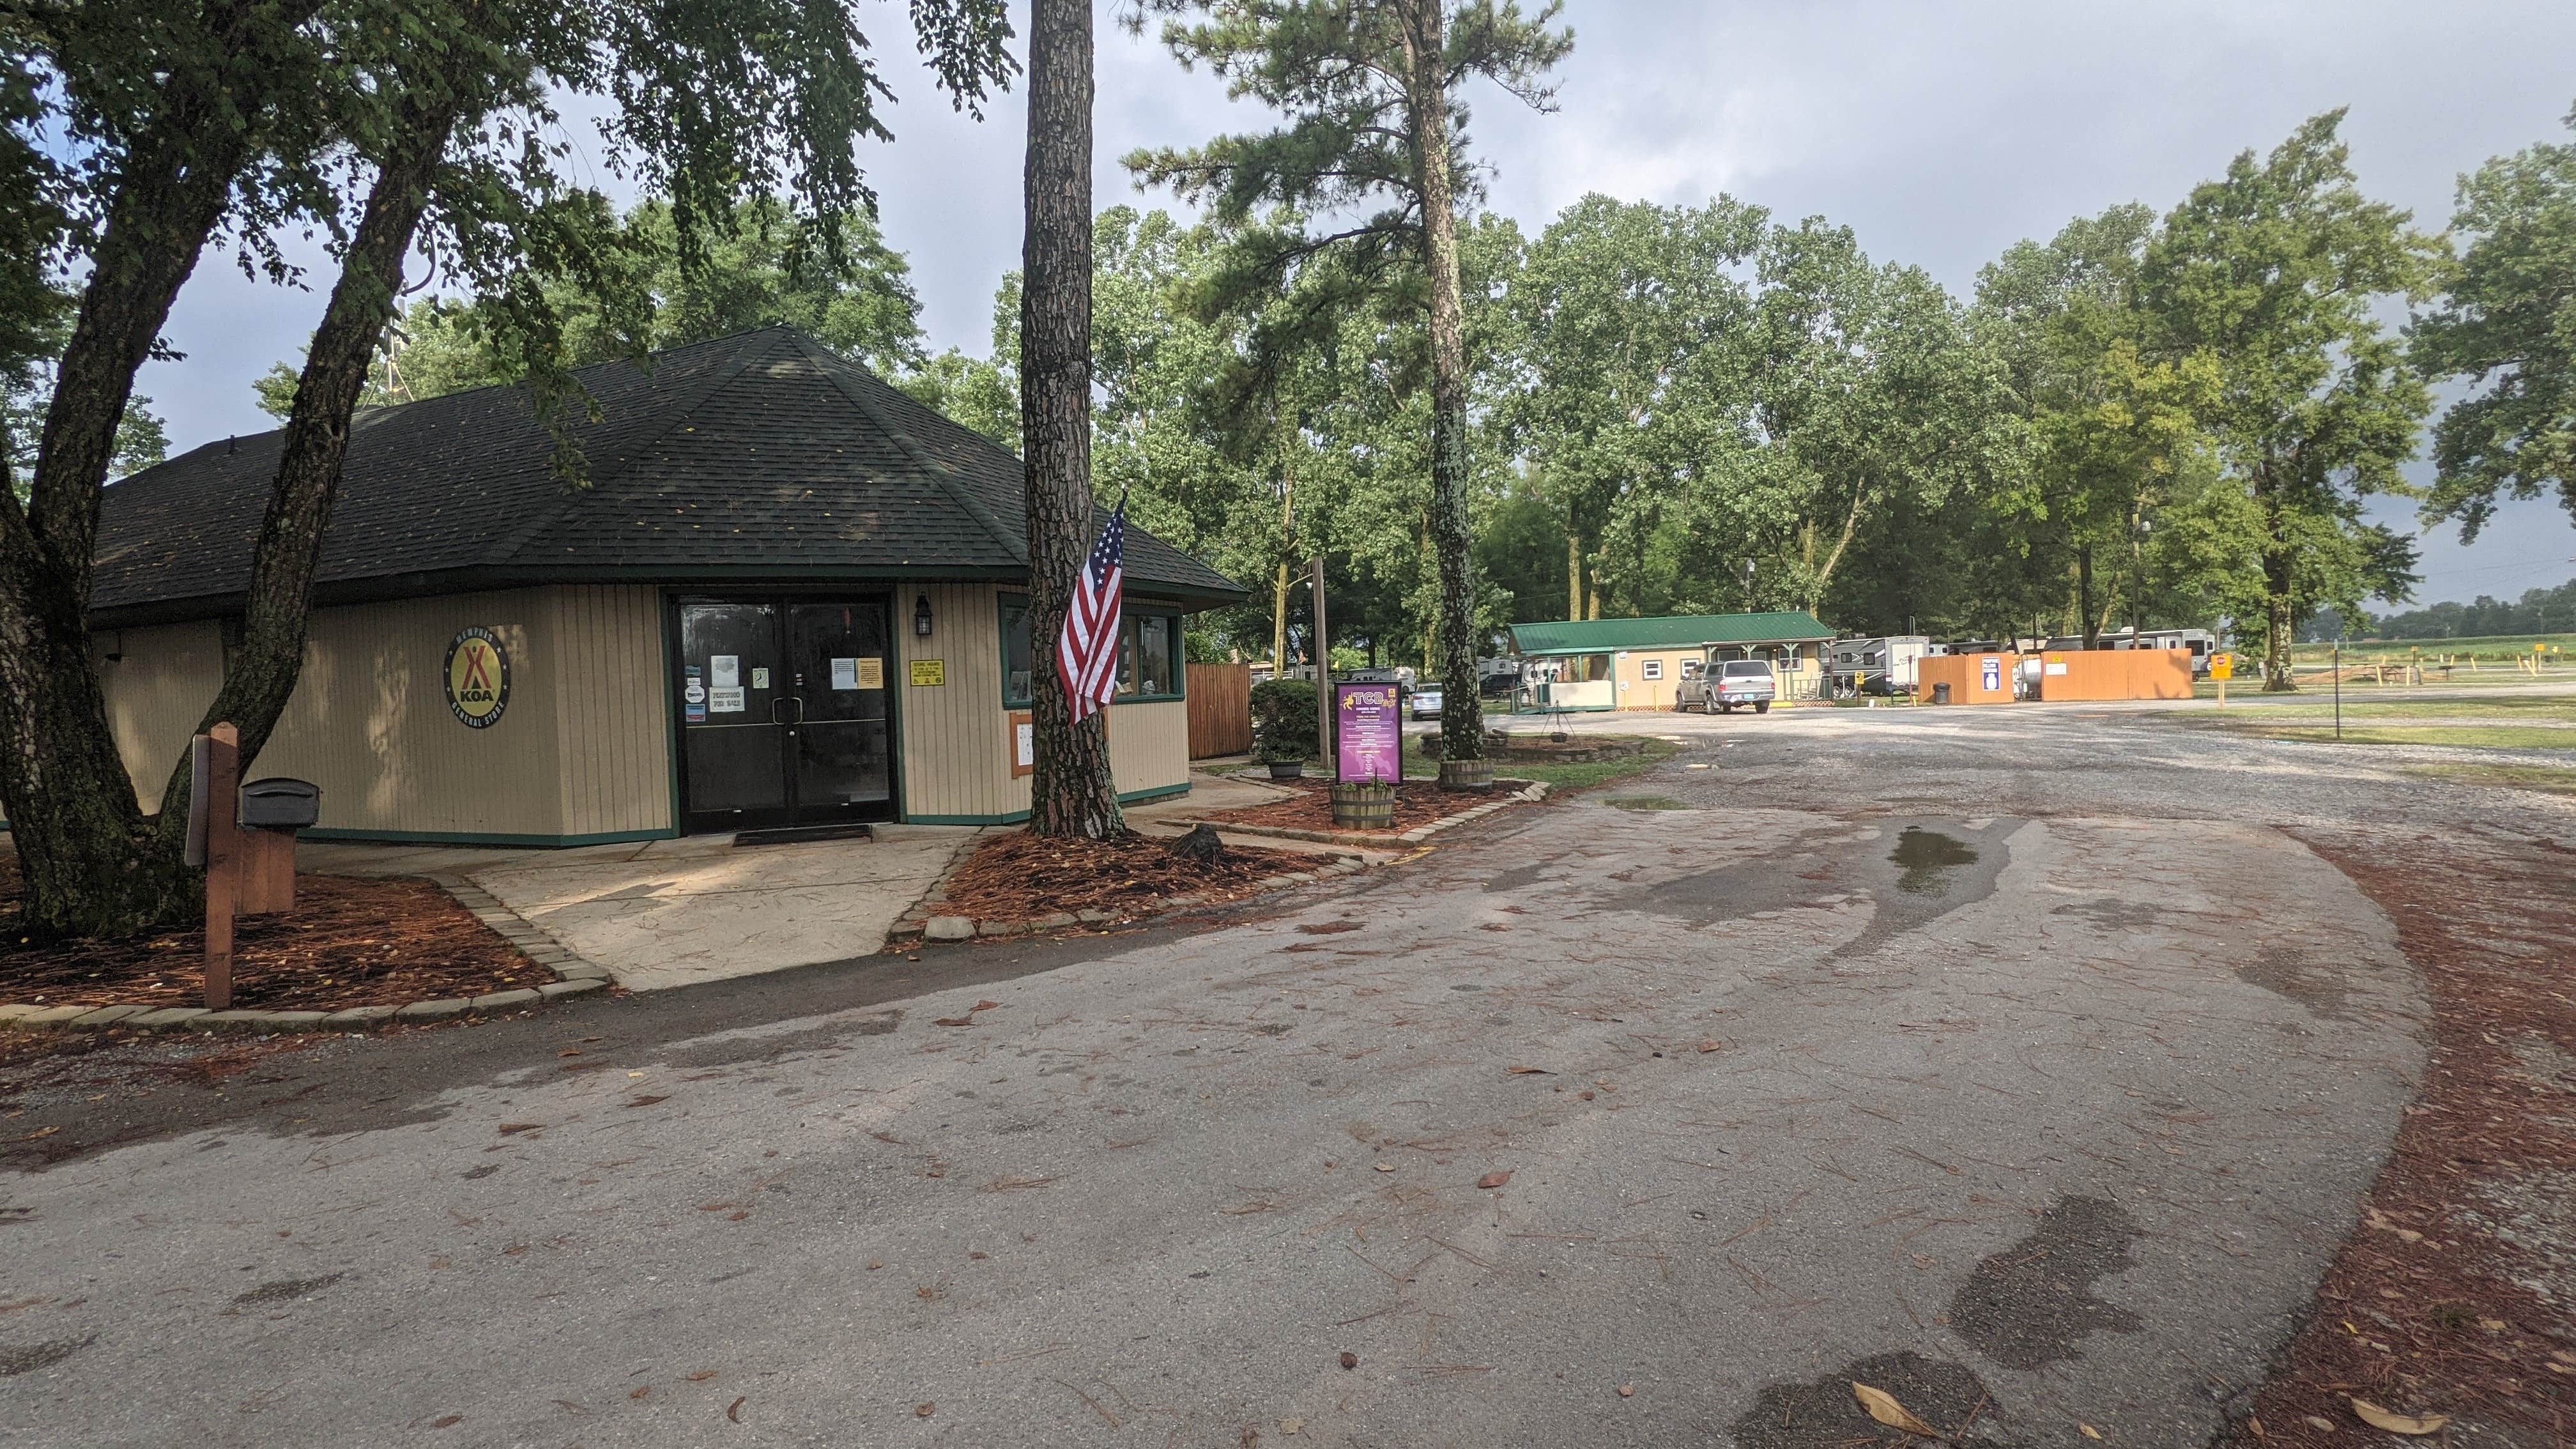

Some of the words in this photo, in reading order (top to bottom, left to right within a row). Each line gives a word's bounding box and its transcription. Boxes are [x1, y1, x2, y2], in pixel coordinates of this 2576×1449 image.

[456, 627, 493, 645] MEMPHIS
[459, 690, 494, 702] KOA
[1353, 692, 1383, 704] TCB
[451, 702, 482, 727] GENERAL
[485, 700, 505, 724] STORE
